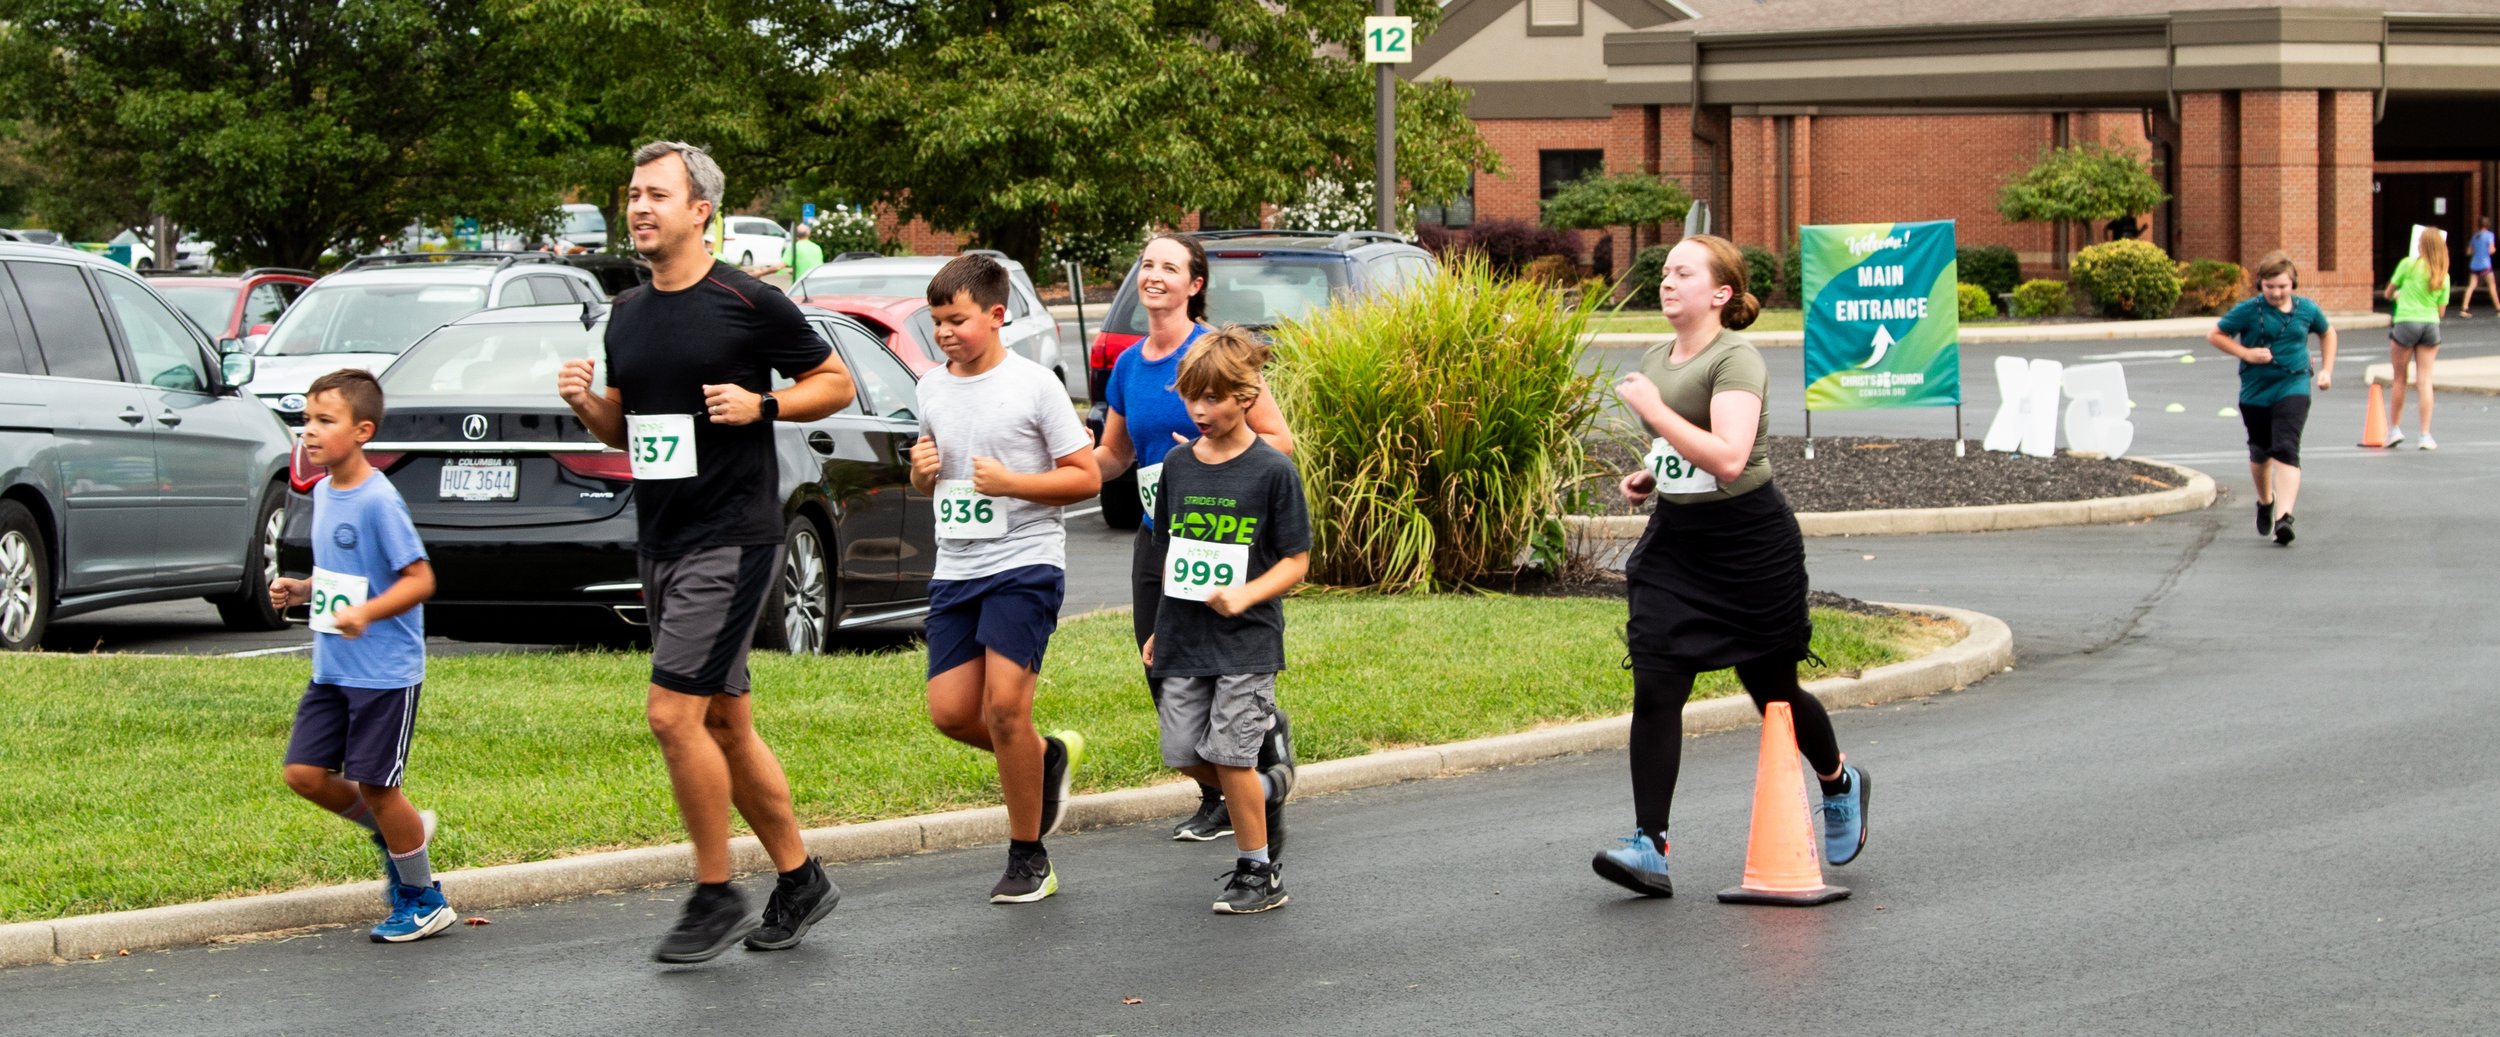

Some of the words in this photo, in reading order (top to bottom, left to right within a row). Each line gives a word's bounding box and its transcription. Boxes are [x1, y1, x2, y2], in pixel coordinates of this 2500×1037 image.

[1368, 27, 1406, 52] 12
[1845, 230, 1911, 256] Welcome!
[1858, 265, 1904, 287] MAIN
[1835, 297, 1928, 321] ENTRANCE
[1840, 375, 1877, 387] CHRIST'S
[1891, 373, 1924, 385] CHURCH
[633, 436, 679, 463] 937
[458, 458, 502, 466] COLUMBIA
[443, 470, 471, 490] HUZ
[476, 470, 511, 491] 3644
[941, 499, 993, 523] 936
[1184, 496, 1216, 506] STRIDES
[1217, 497, 1237, 508] FOR
[1170, 511, 1258, 544] HOPE
[1173, 558, 1234, 586] 999
